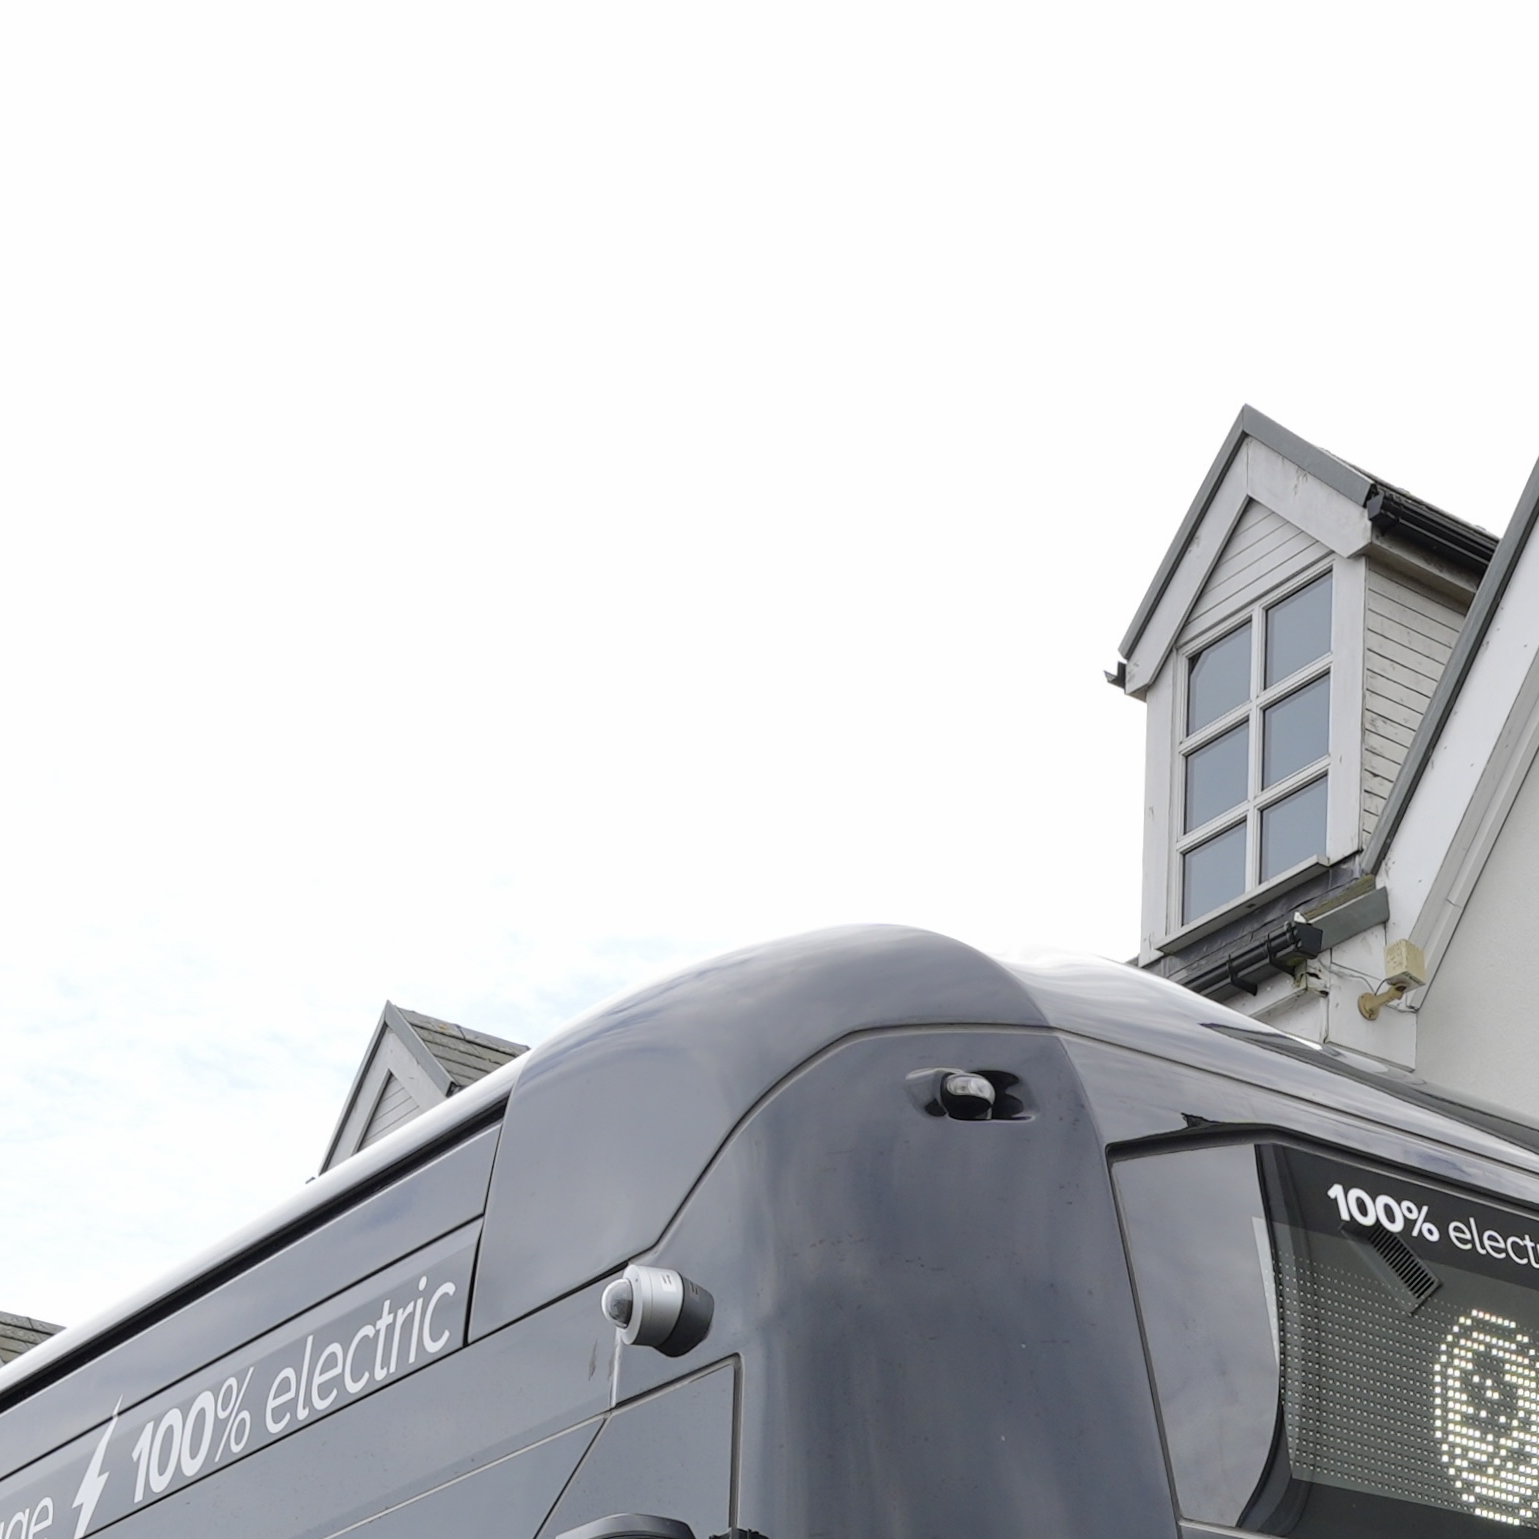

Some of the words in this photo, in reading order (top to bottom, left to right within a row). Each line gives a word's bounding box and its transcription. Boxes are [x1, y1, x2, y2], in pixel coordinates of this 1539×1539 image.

[1326, 1183, 1440, 1242] 100%
[131, 1366, 254, 1503] 100%
[265, 1275, 456, 1434] electric
